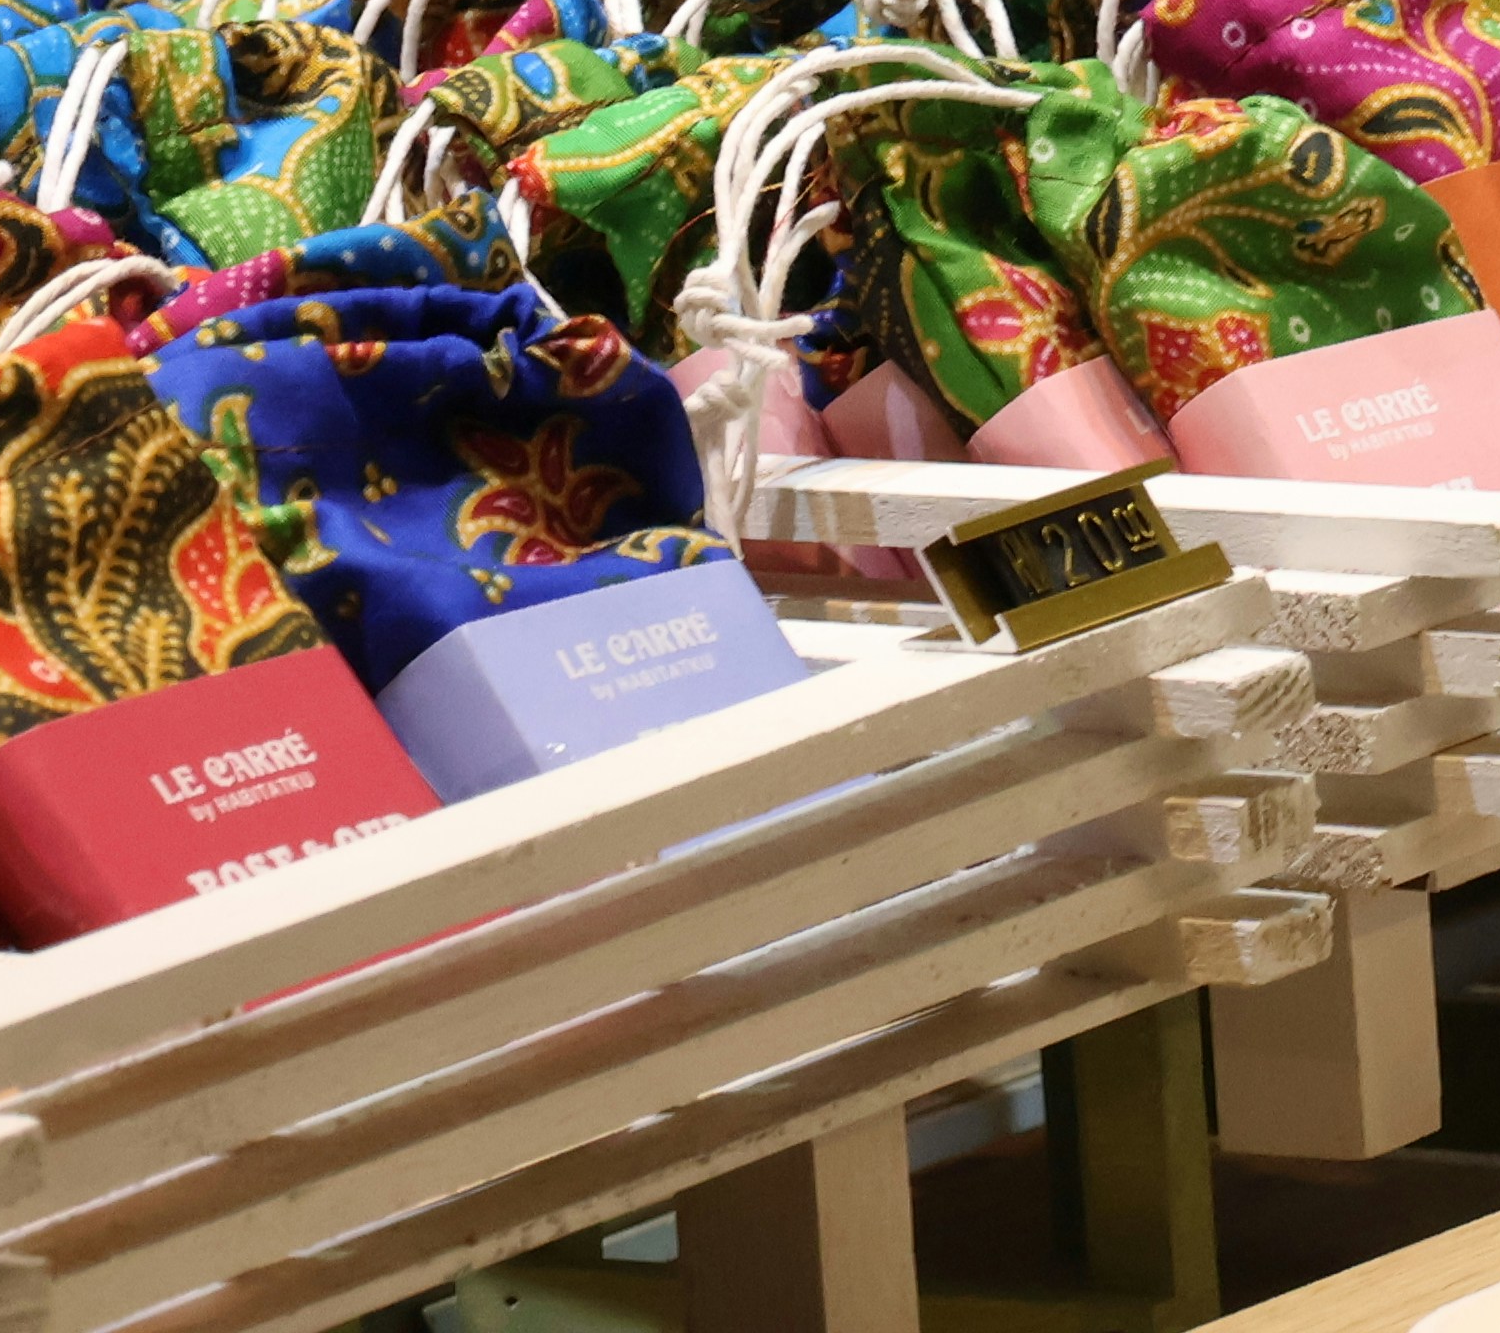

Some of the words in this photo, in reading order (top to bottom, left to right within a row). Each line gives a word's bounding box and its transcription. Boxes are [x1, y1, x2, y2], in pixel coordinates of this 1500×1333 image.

[1295, 408, 1341, 442] LE
[1341, 377, 1440, 431] CARRÉ
[556, 641, 607, 680] LE
[606, 606, 718, 665] CARRÉ
[149, 764, 207, 805] LE
[202, 727, 318, 788] CARRÉ
[186, 802, 217, 823] by
[214, 771, 317, 814] HABITATKU
